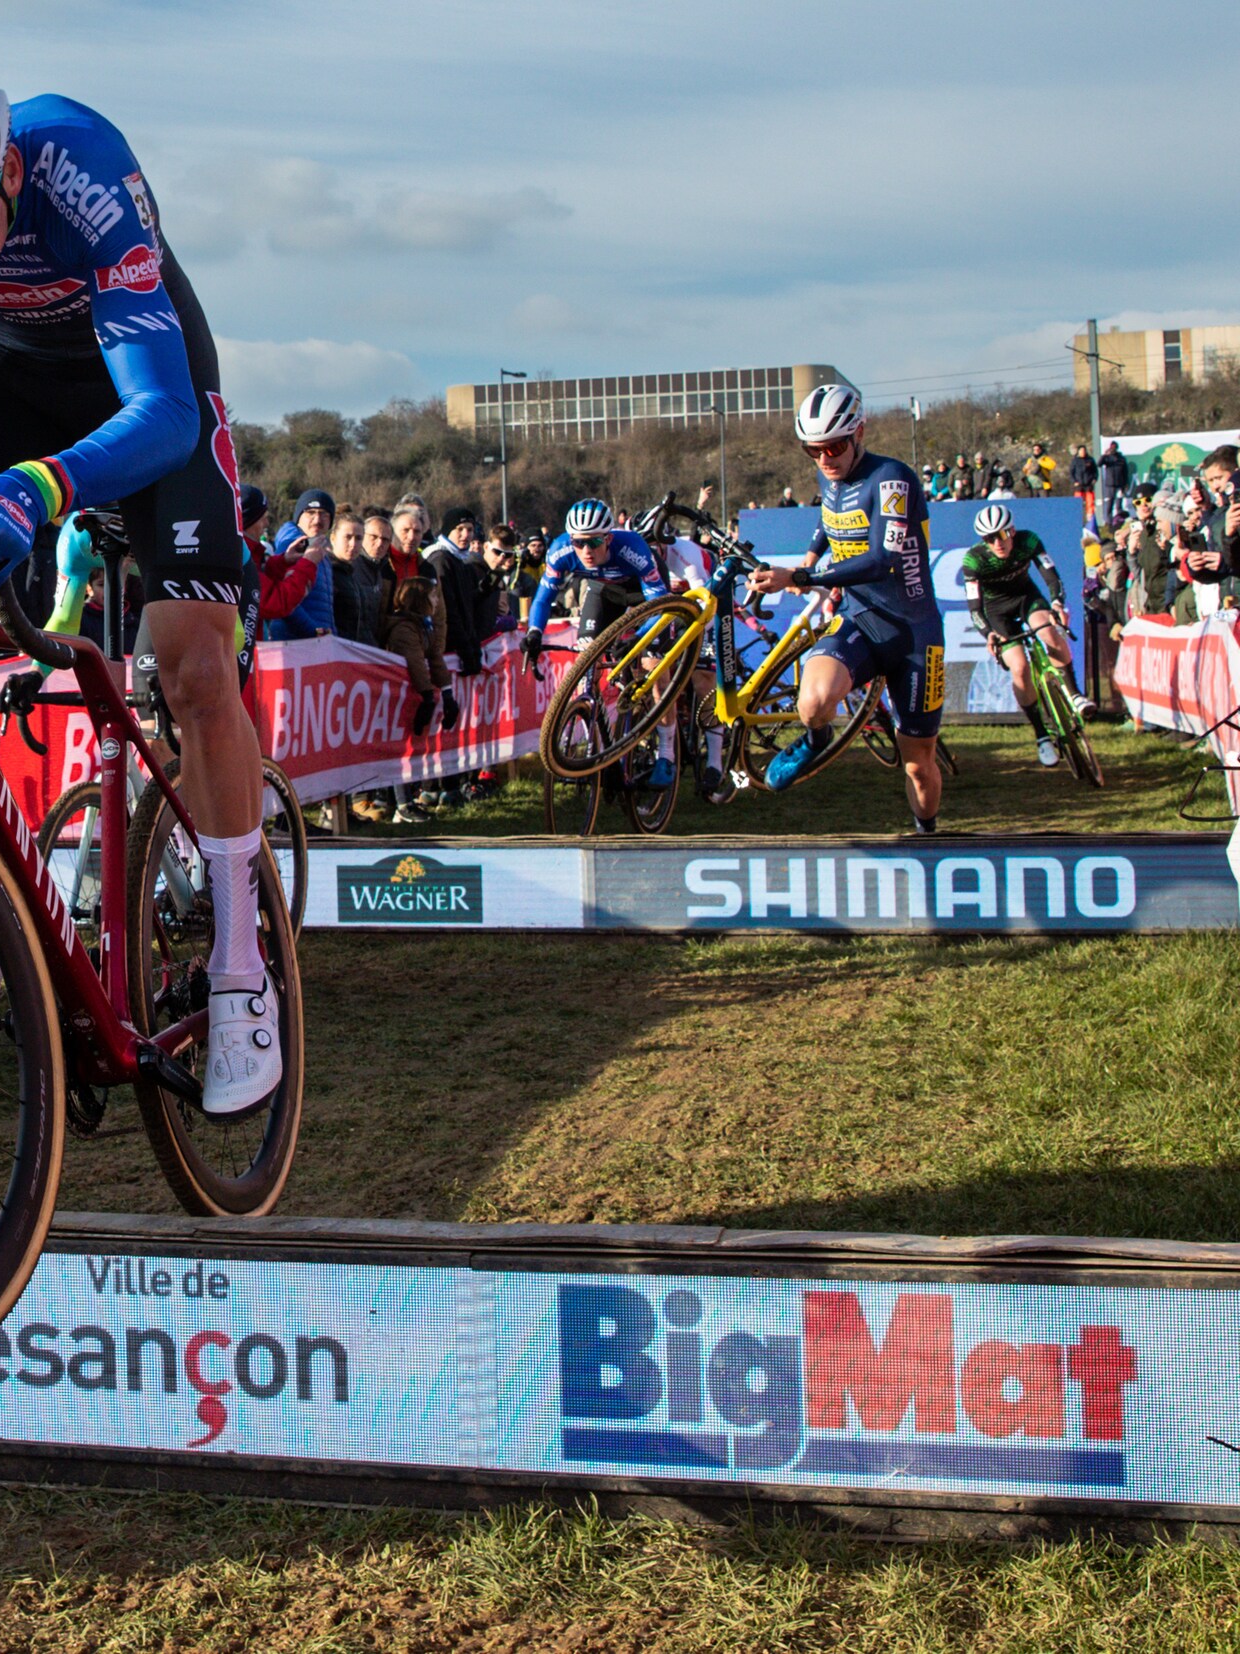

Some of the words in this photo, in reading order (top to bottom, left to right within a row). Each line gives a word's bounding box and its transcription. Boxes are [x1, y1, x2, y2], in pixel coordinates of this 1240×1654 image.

[32, 140, 125, 237] Alpecin
[51, 195, 101, 247] BOOSTER
[0, 498, 31, 530] Alpecin
[886, 530, 905, 545] 38
[721, 614, 736, 683] cannondale
[350, 886, 470, 911] WAGNER
[686, 856, 1137, 919] SHIMANO
[87, 1255, 172, 1297] Ville
[182, 1261, 230, 1300] de
[558, 1282, 1139, 1470] BigMat
